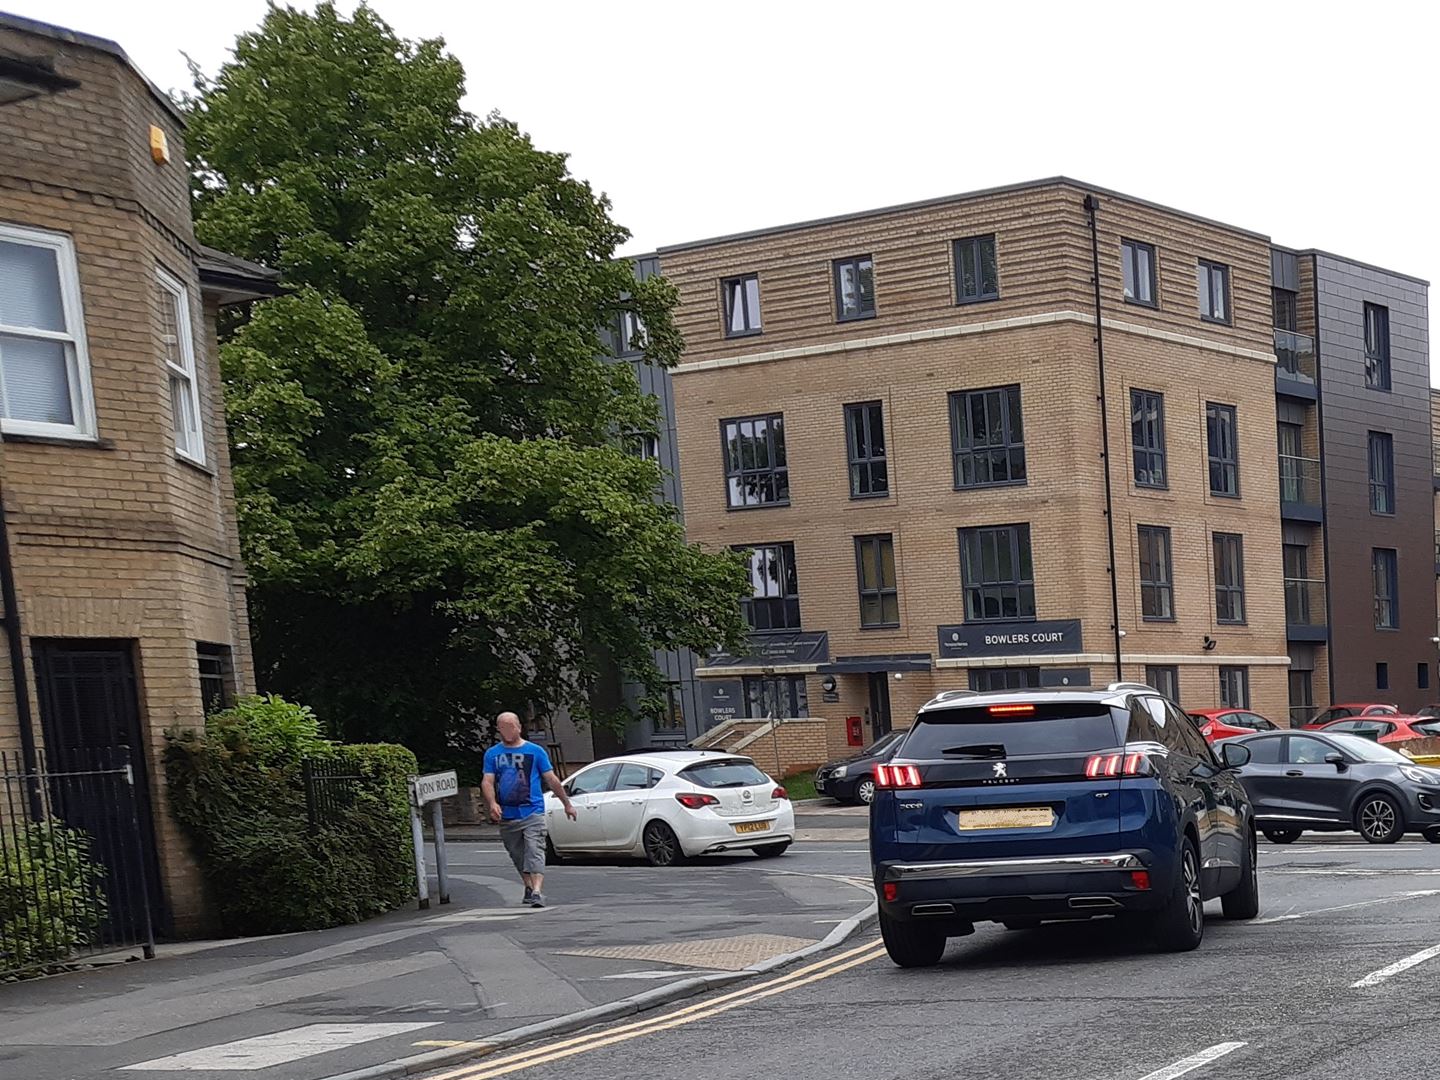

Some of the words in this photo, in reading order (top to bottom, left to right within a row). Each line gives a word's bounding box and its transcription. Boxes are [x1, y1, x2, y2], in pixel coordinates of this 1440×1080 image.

[985, 634, 1029, 645] BOWLERS
[1032, 632, 1063, 642] COURT
[436, 778, 456, 792] ROAD
